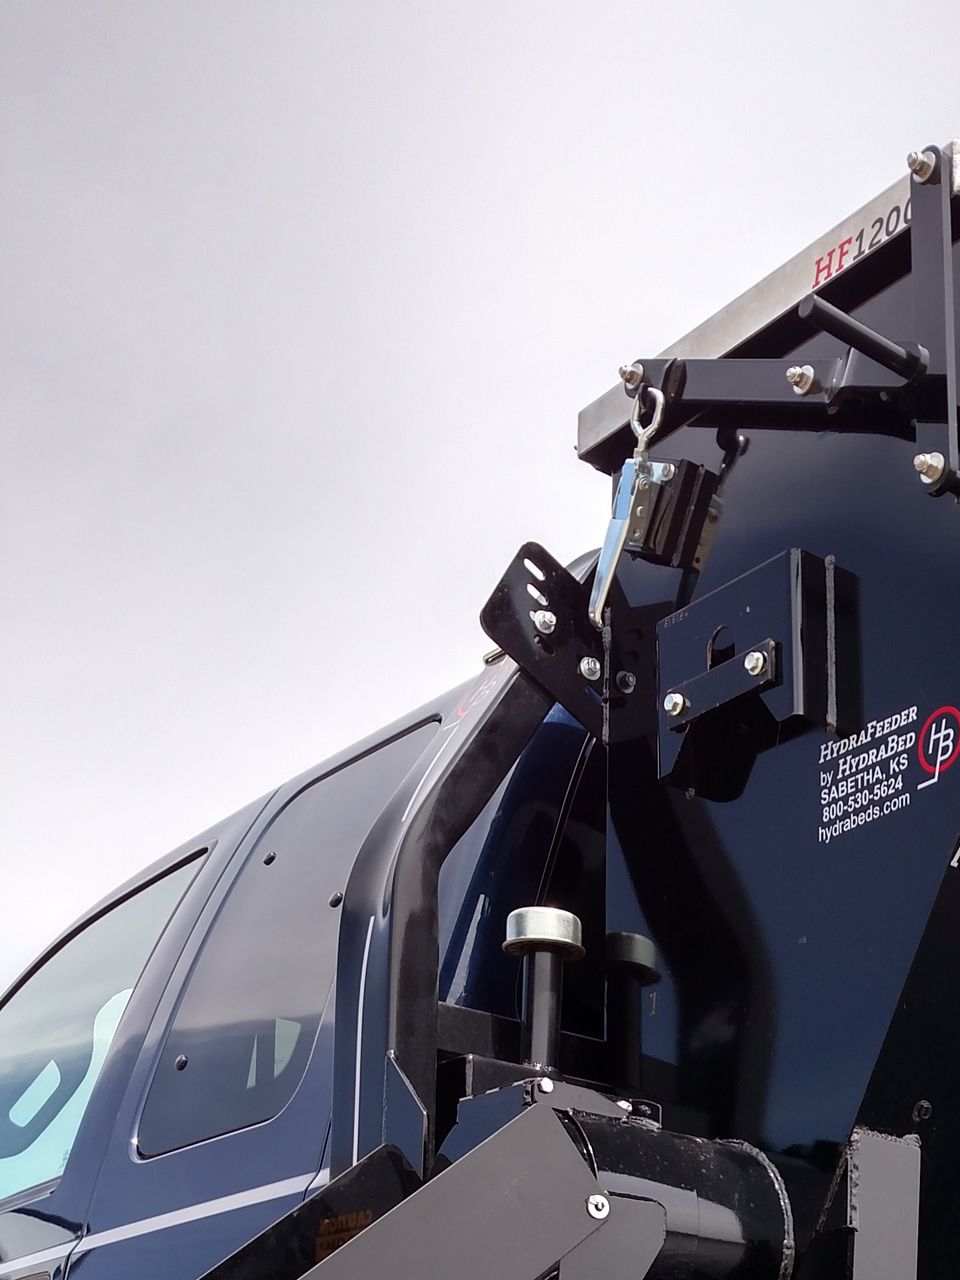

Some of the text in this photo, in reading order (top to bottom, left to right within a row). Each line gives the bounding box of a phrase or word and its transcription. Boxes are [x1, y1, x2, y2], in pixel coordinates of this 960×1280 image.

[818, 705, 918, 764] HYDRAFEEDER
[820, 732, 916, 787] by HYDRABED
[820, 753, 909, 804] SABETHA, KS
[822, 774, 903, 822] 800-530-5624
[818, 792, 911, 843] hydrabeds.com
